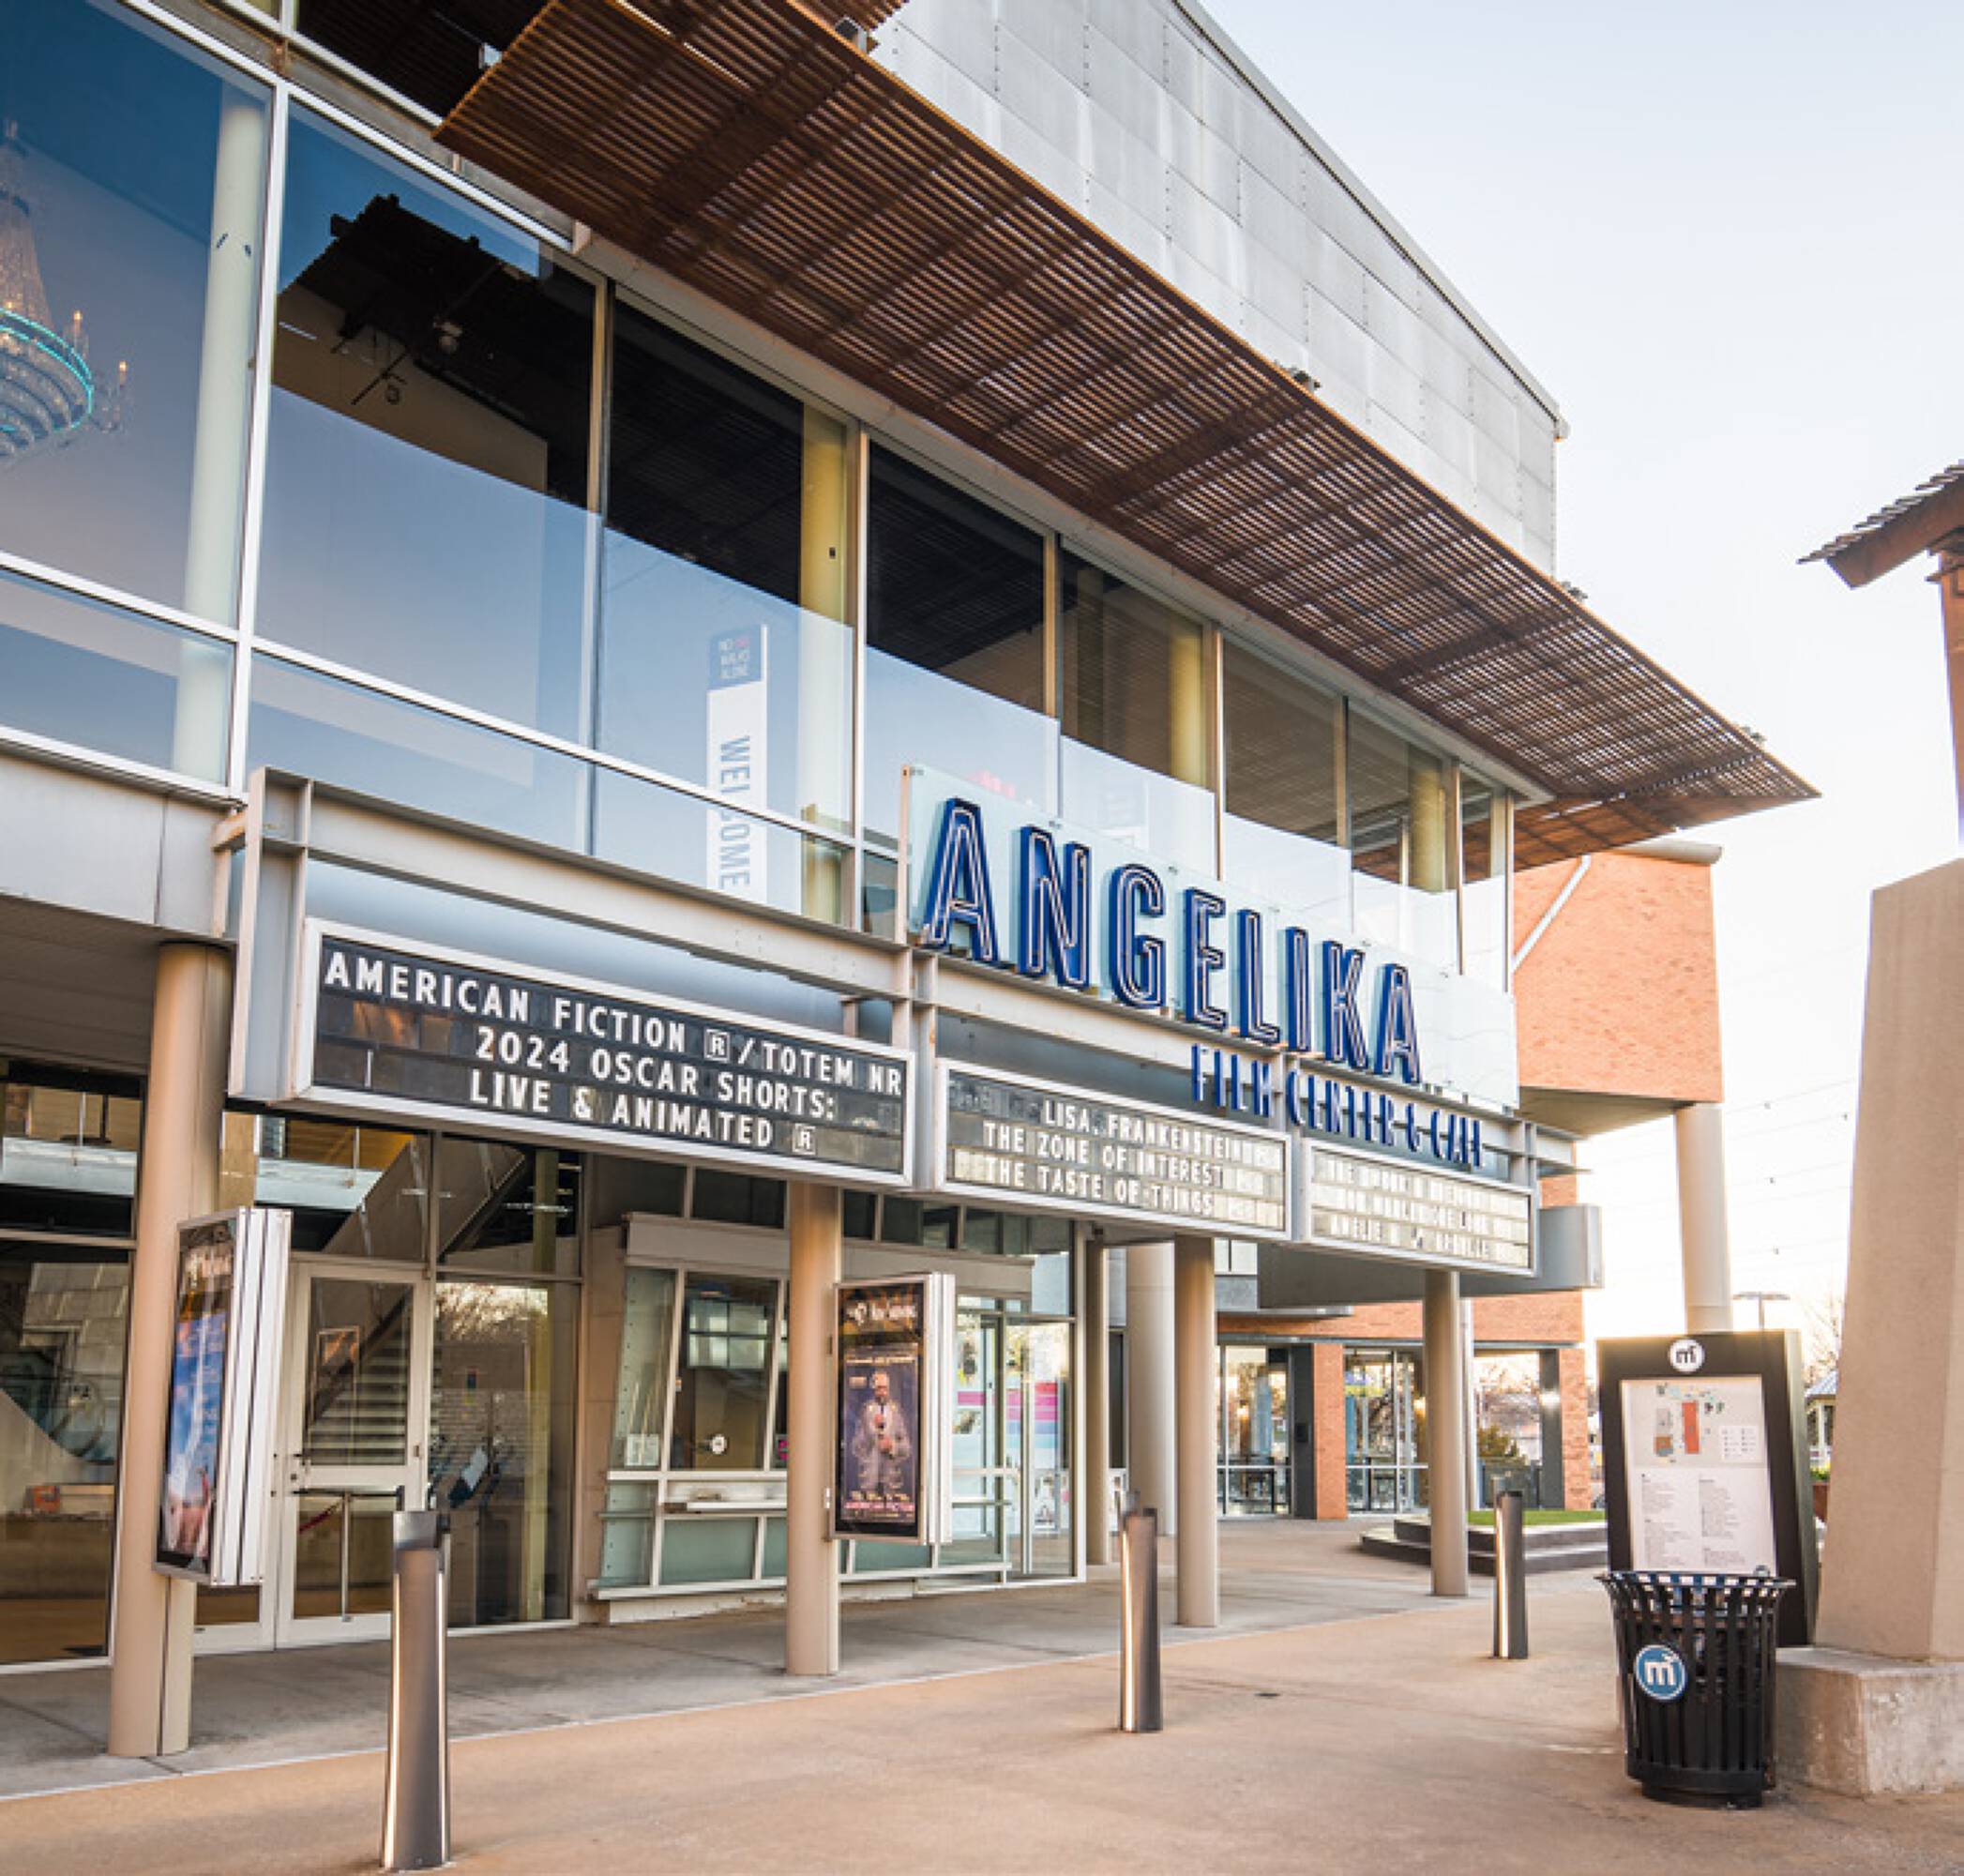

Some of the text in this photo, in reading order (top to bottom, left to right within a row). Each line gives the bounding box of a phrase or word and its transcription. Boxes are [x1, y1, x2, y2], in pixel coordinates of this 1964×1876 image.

[720, 734, 750, 890] WELOME
[920, 797, 1421, 1084] ANGELIKA
[325, 951, 529, 1022] AMERICAN
[552, 997, 686, 1053] FICTION
[869, 1063, 902, 1096] NR
[470, 1068, 551, 1113] LIVE
[573, 1085, 594, 1119] &
[612, 1094, 774, 1147] ANIMATED
[476, 1026, 835, 1122] 2024 OSCAR SHORTS:
[983, 1122, 1223, 1188] THE ZONE OF INTEREST
[985, 1156, 1025, 1187] THE
[1037, 1164, 1102, 1199] TASTE
[1116, 1178, 1139, 1204] OF
